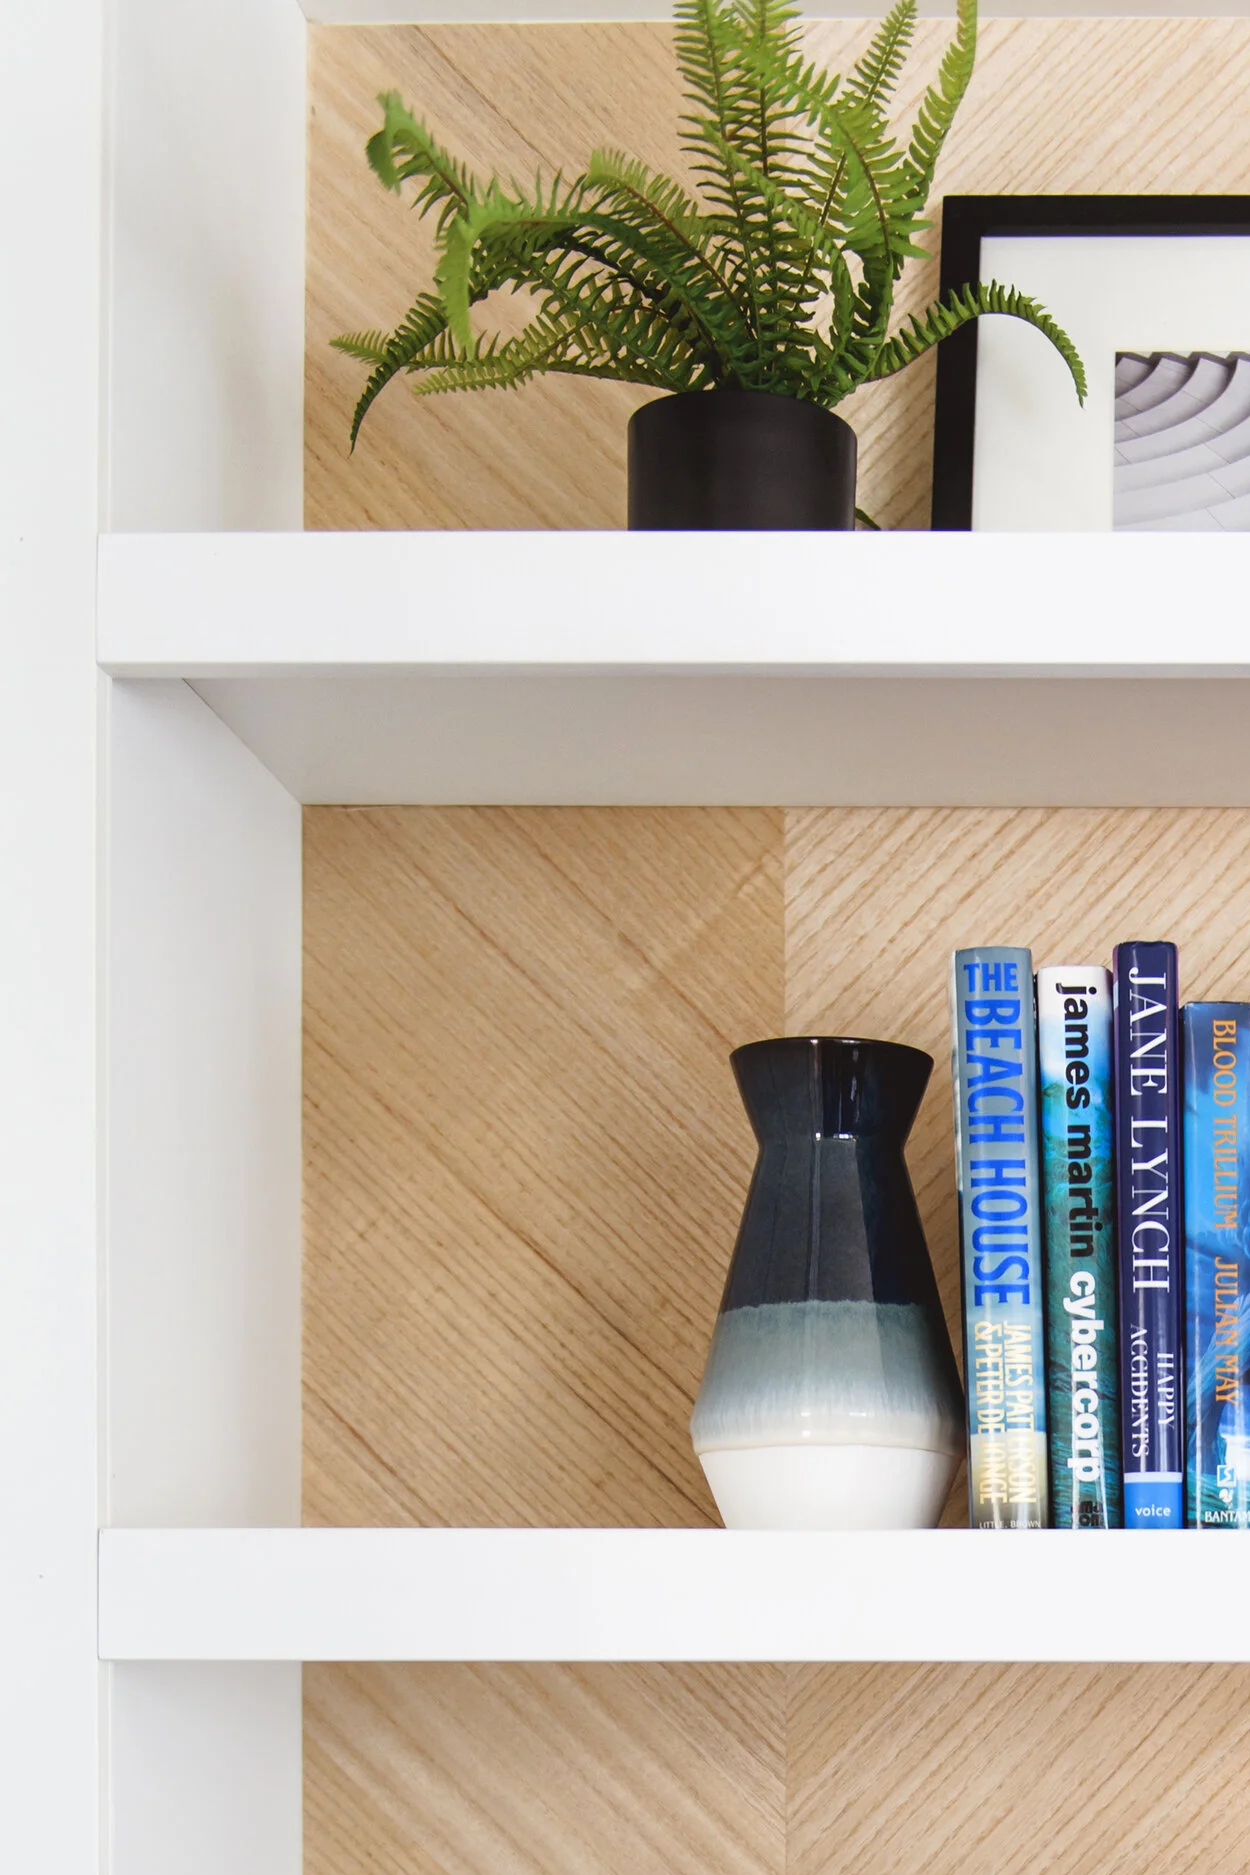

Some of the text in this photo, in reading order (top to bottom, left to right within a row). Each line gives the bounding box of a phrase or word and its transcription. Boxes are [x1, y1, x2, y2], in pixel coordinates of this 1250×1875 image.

[964, 962, 1019, 993] THE
[965, 999, 1031, 1307] BEACH HOUSE
[1056, 982, 1103, 1258] james martin
[1128, 966, 1170, 1293] JANE LYNCH
[1212, 1019, 1239, 1230] BLOOD TRILLIUM
[975, 1343, 1004, 1406] PETER
[1063, 1270, 1105, 1482] cybercorp
[1130, 1323, 1150, 1458] ACCIDENTS
[1157, 1352, 1175, 1429] HAPPY
[1214, 1256, 1240, 1406] JULIAN MAY
[977, 1408, 1006, 1435] DE
[979, 1438, 1008, 1505] JONGE
[1003, 1320, 1038, 1504] JAMES PATTERSON
[1135, 1504, 1171, 1517] voice
[1204, 1510, 1250, 1523] BANTAM
